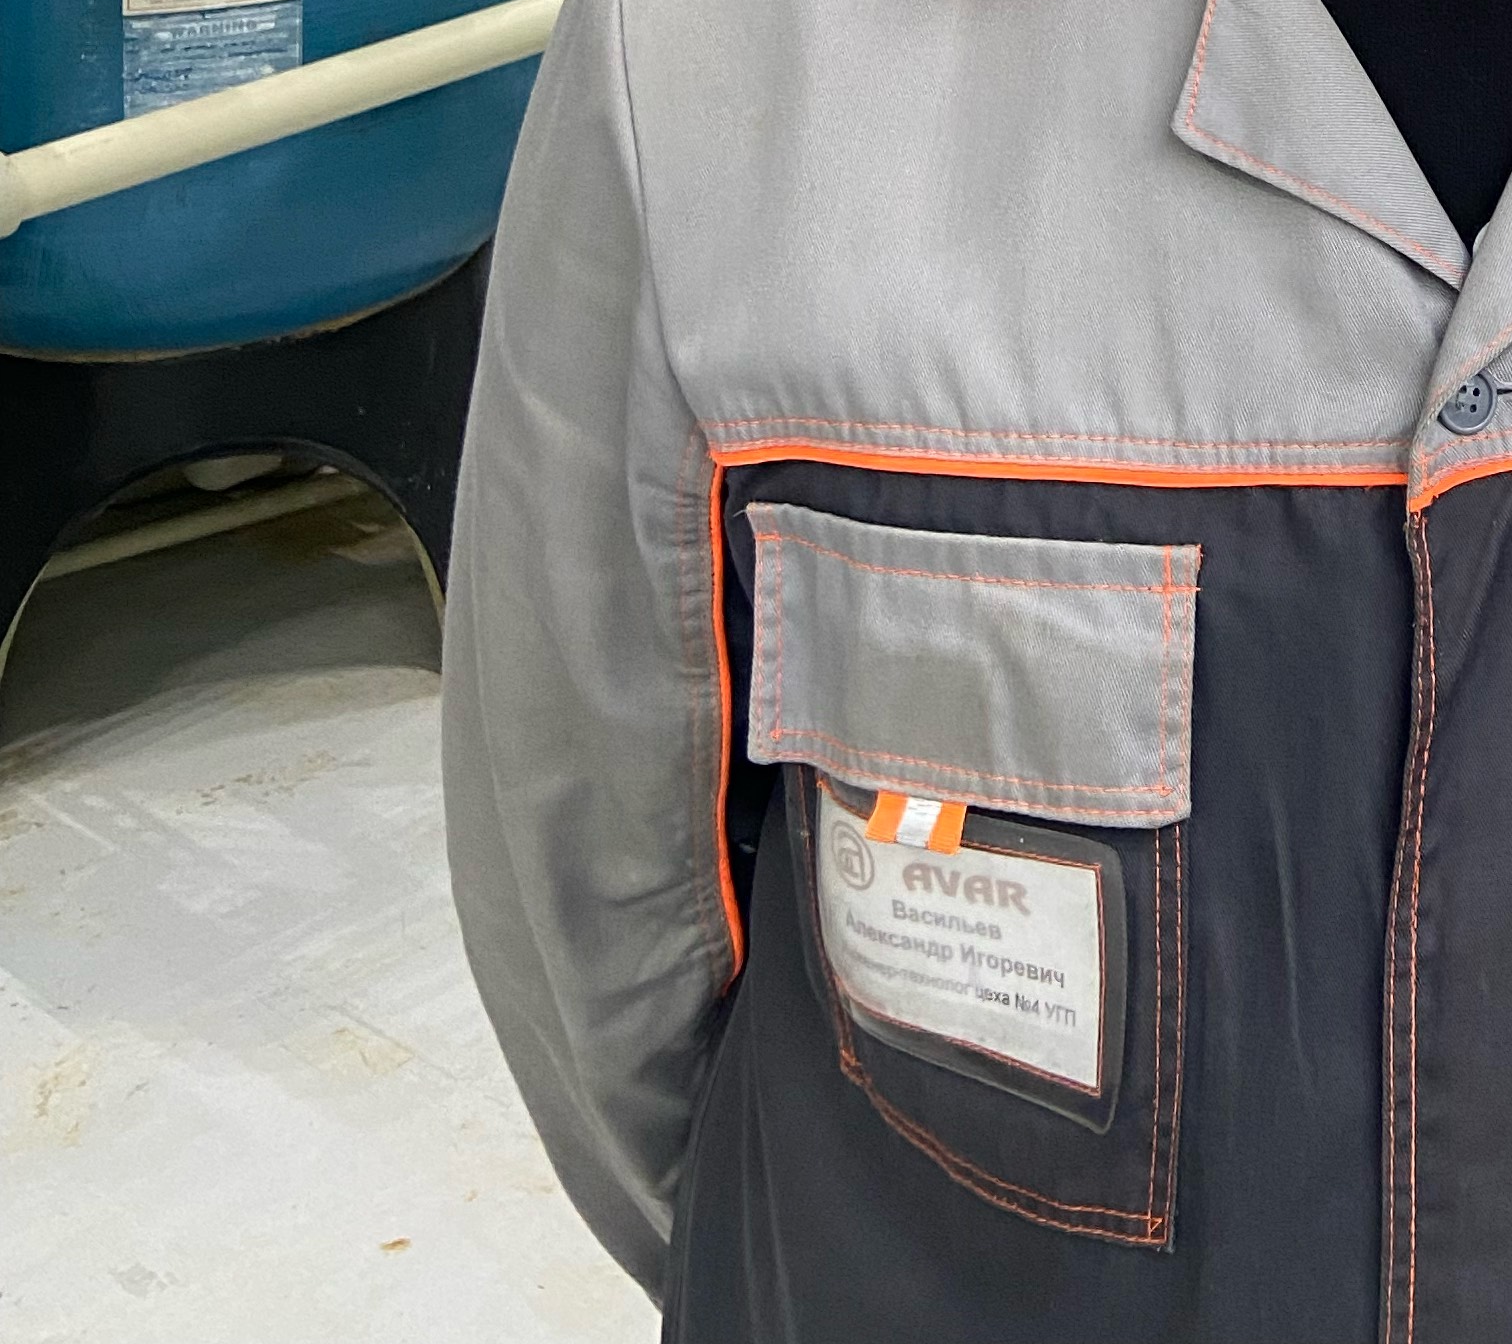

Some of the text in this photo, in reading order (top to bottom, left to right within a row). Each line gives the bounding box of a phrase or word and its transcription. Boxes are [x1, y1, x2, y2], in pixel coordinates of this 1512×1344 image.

[902, 863, 1032, 917] AVAR
[892, 898, 1003, 941] Васильев
[846, 911, 1065, 989] Александр Игоревич
[975, 984, 1011, 1006] цеха
[1015, 992, 1041, 1016] №4
